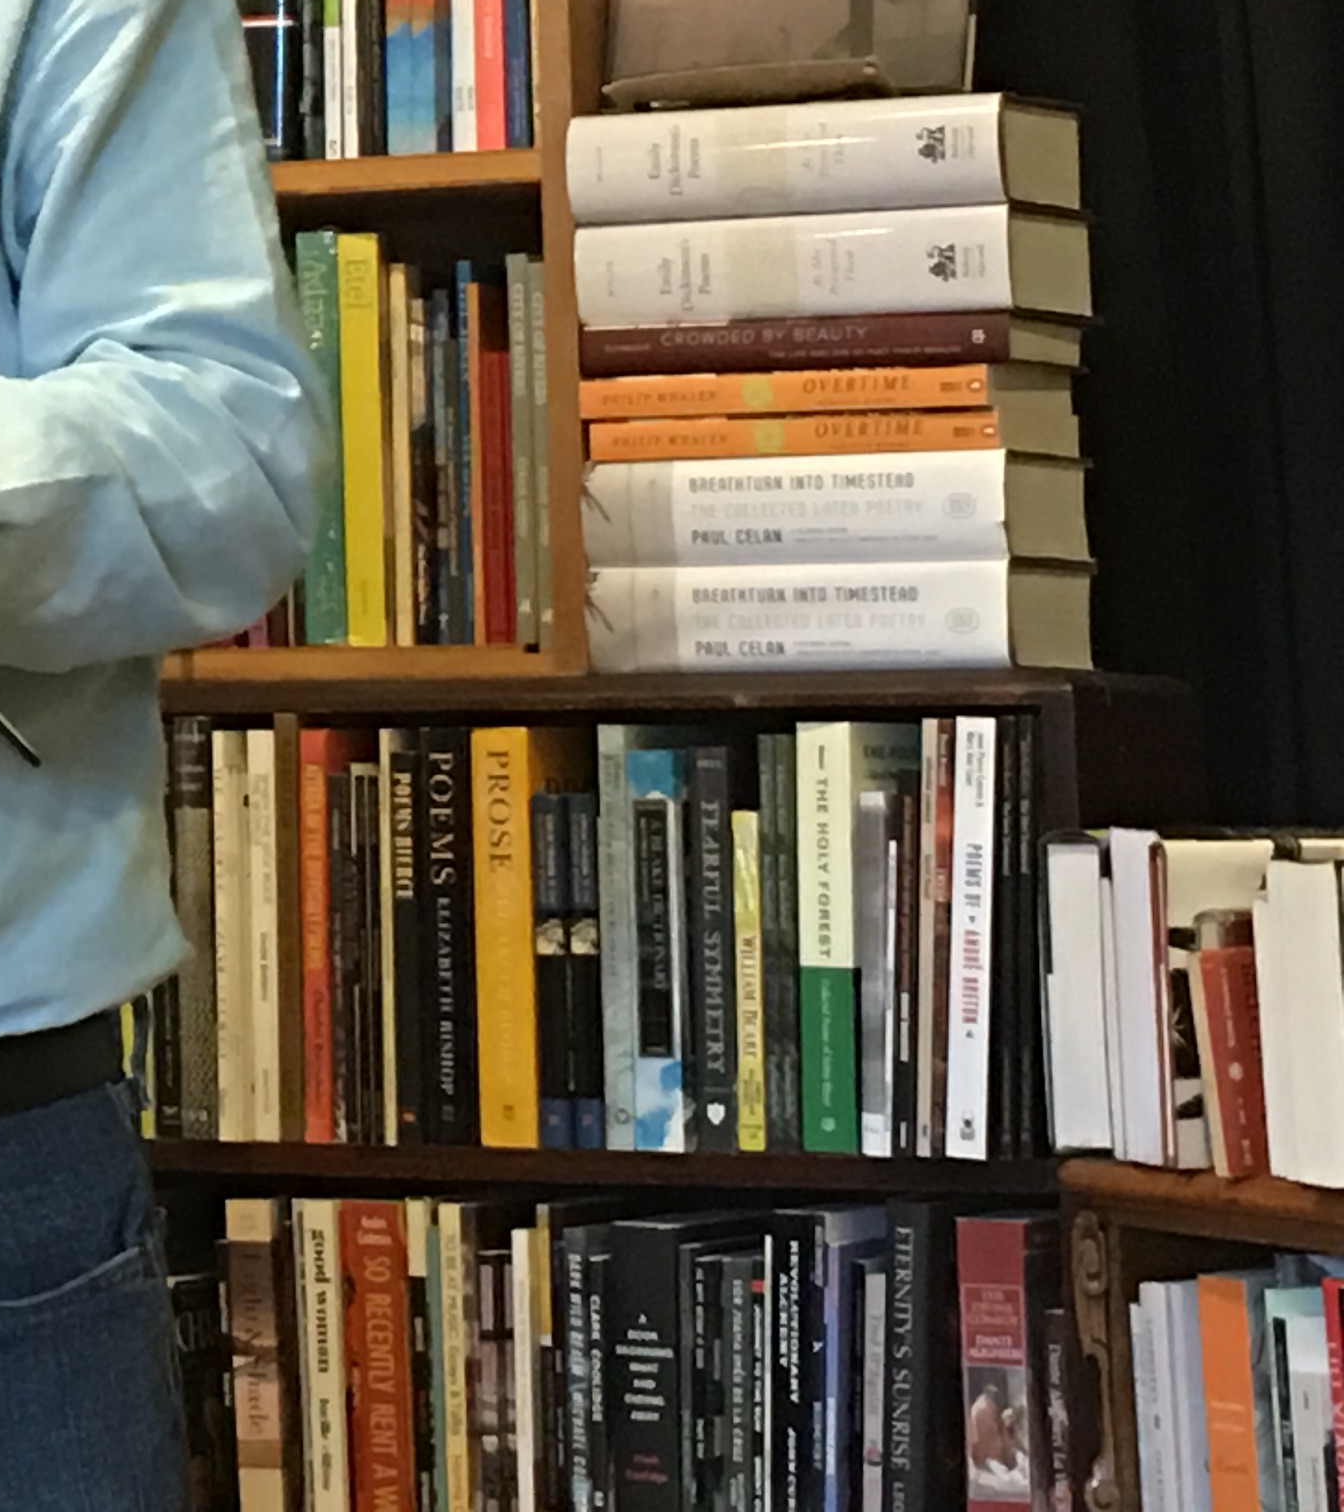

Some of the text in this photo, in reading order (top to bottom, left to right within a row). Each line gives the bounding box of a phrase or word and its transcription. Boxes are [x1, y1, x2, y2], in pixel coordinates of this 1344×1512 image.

[648, 143, 663, 180] Emily
[345, 257, 373, 311] Etel
[512, 282, 526, 319] CITY
[532, 292, 545, 326] CITY
[659, 329, 755, 348] CROWDED
[762, 327, 787, 344] BY
[794, 325, 870, 344] BEAUTY
[602, 389, 718, 406] PHILIP WHALEN
[803, 374, 912, 395] OVERTIME
[613, 432, 729, 447] PHILIP WHALEN
[814, 418, 924, 439] OVERTIME
[688, 472, 915, 493] BREATHTURN INTO TIMESTEAD
[691, 528, 730, 546] PAUL
[735, 528, 783, 545] CELAN
[692, 585, 920, 604] BREATHTURN INTO TIMESTEAD
[695, 640, 733, 657] PAUL
[738, 639, 786, 657] CELAN
[393, 772, 413, 832] POEMS
[486, 750, 513, 874] PROSE
[815, 777, 832, 959] THE HOLY FOREST
[428, 752, 457, 1096] POEMS ELIZABETH BISHOP
[701, 801, 725, 1074] FEARFUL SYMMETRY
[961, 843, 985, 1024] POEMS OF ANDRÉ BRETON
[740, 935, 758, 1060] WILLIAM BLAKE
[310, 1228, 330, 1284] good
[732, 1279, 743, 1305] SOR
[892, 1226, 914, 1359] ETERNITY'S
[316, 1291, 330, 1374] woman
[638, 1313, 647, 1324] A
[732, 1308, 743, 1351] JUANA
[778, 1272, 788, 1368] ALCHEMY
[789, 1240, 800, 1404] REVOLUTIONARY
[364, 1256, 398, 1488] SO RECENTLY RENT A
[567, 1253, 586, 1450] DARK WILD REALM MICHAEL
[589, 1294, 603, 1422] CLARK COOLIDGE
[733, 1387, 743, 1404] DE
[733, 1407, 743, 1424] LA
[891, 1369, 912, 1471] SUNRISE
